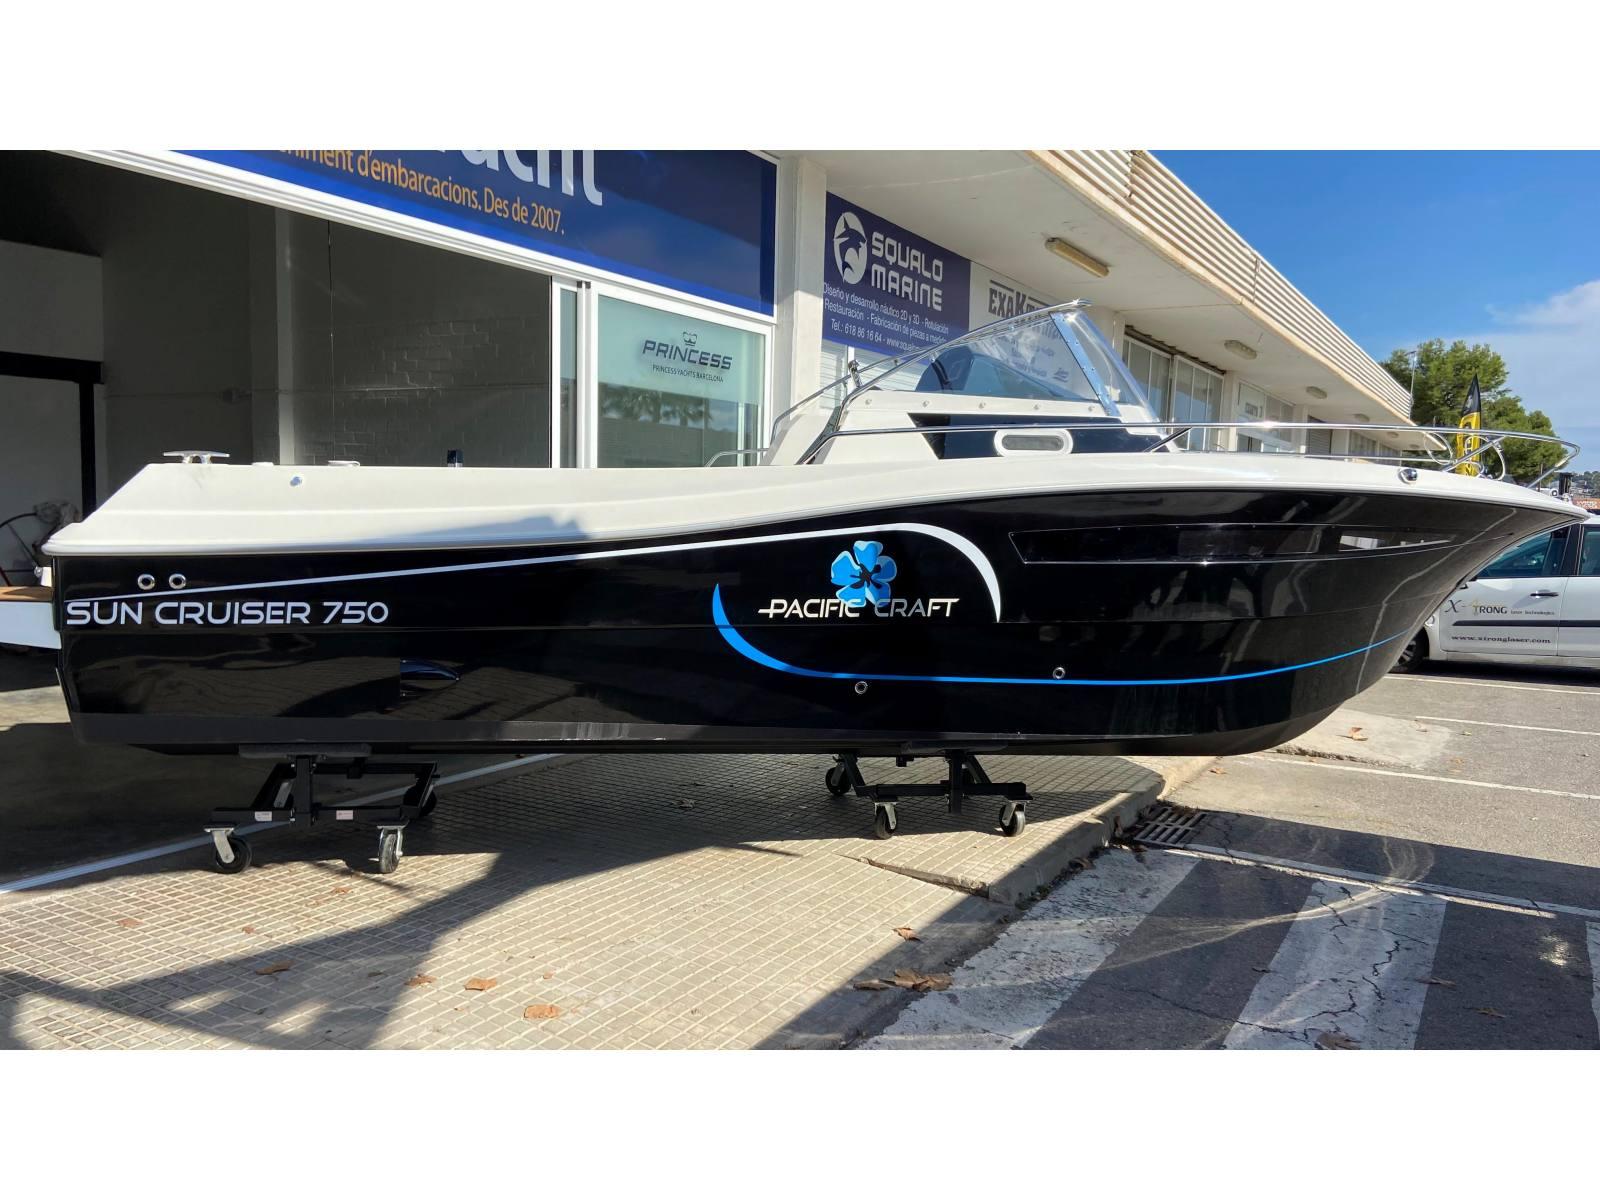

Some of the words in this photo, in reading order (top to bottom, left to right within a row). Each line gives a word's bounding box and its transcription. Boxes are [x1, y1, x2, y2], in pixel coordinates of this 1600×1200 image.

[484, 187, 509, 218] Des
[512, 196, 529, 224] de
[531, 203, 565, 235] 2007.
[871, 231, 943, 282] SQUALO
[871, 263, 943, 312] MARINE
[824, 298, 864, 320] Restauración
[870, 313, 902, 332] Fabricación
[902, 324, 909, 335] de
[910, 329, 925, 340] piezas
[845, 292, 850, 304] y
[850, 293, 880, 311] desarrollo
[900, 309, 908, 321] 2D
[912, 313, 920, 325] 3D
[642, 340, 733, 370] PRINCESS
[652, 364, 677, 375] PRINCESS
[677, 369, 695, 378] YACHTS
[695, 372, 724, 383] BARCELONA
[66, 602, 143, 625] SUN
[154, 602, 310, 625] CRUISER
[323, 602, 389, 624] 750
[758, 598, 860, 619] PACIFIC
[874, 598, 960, 618] CRAFT
